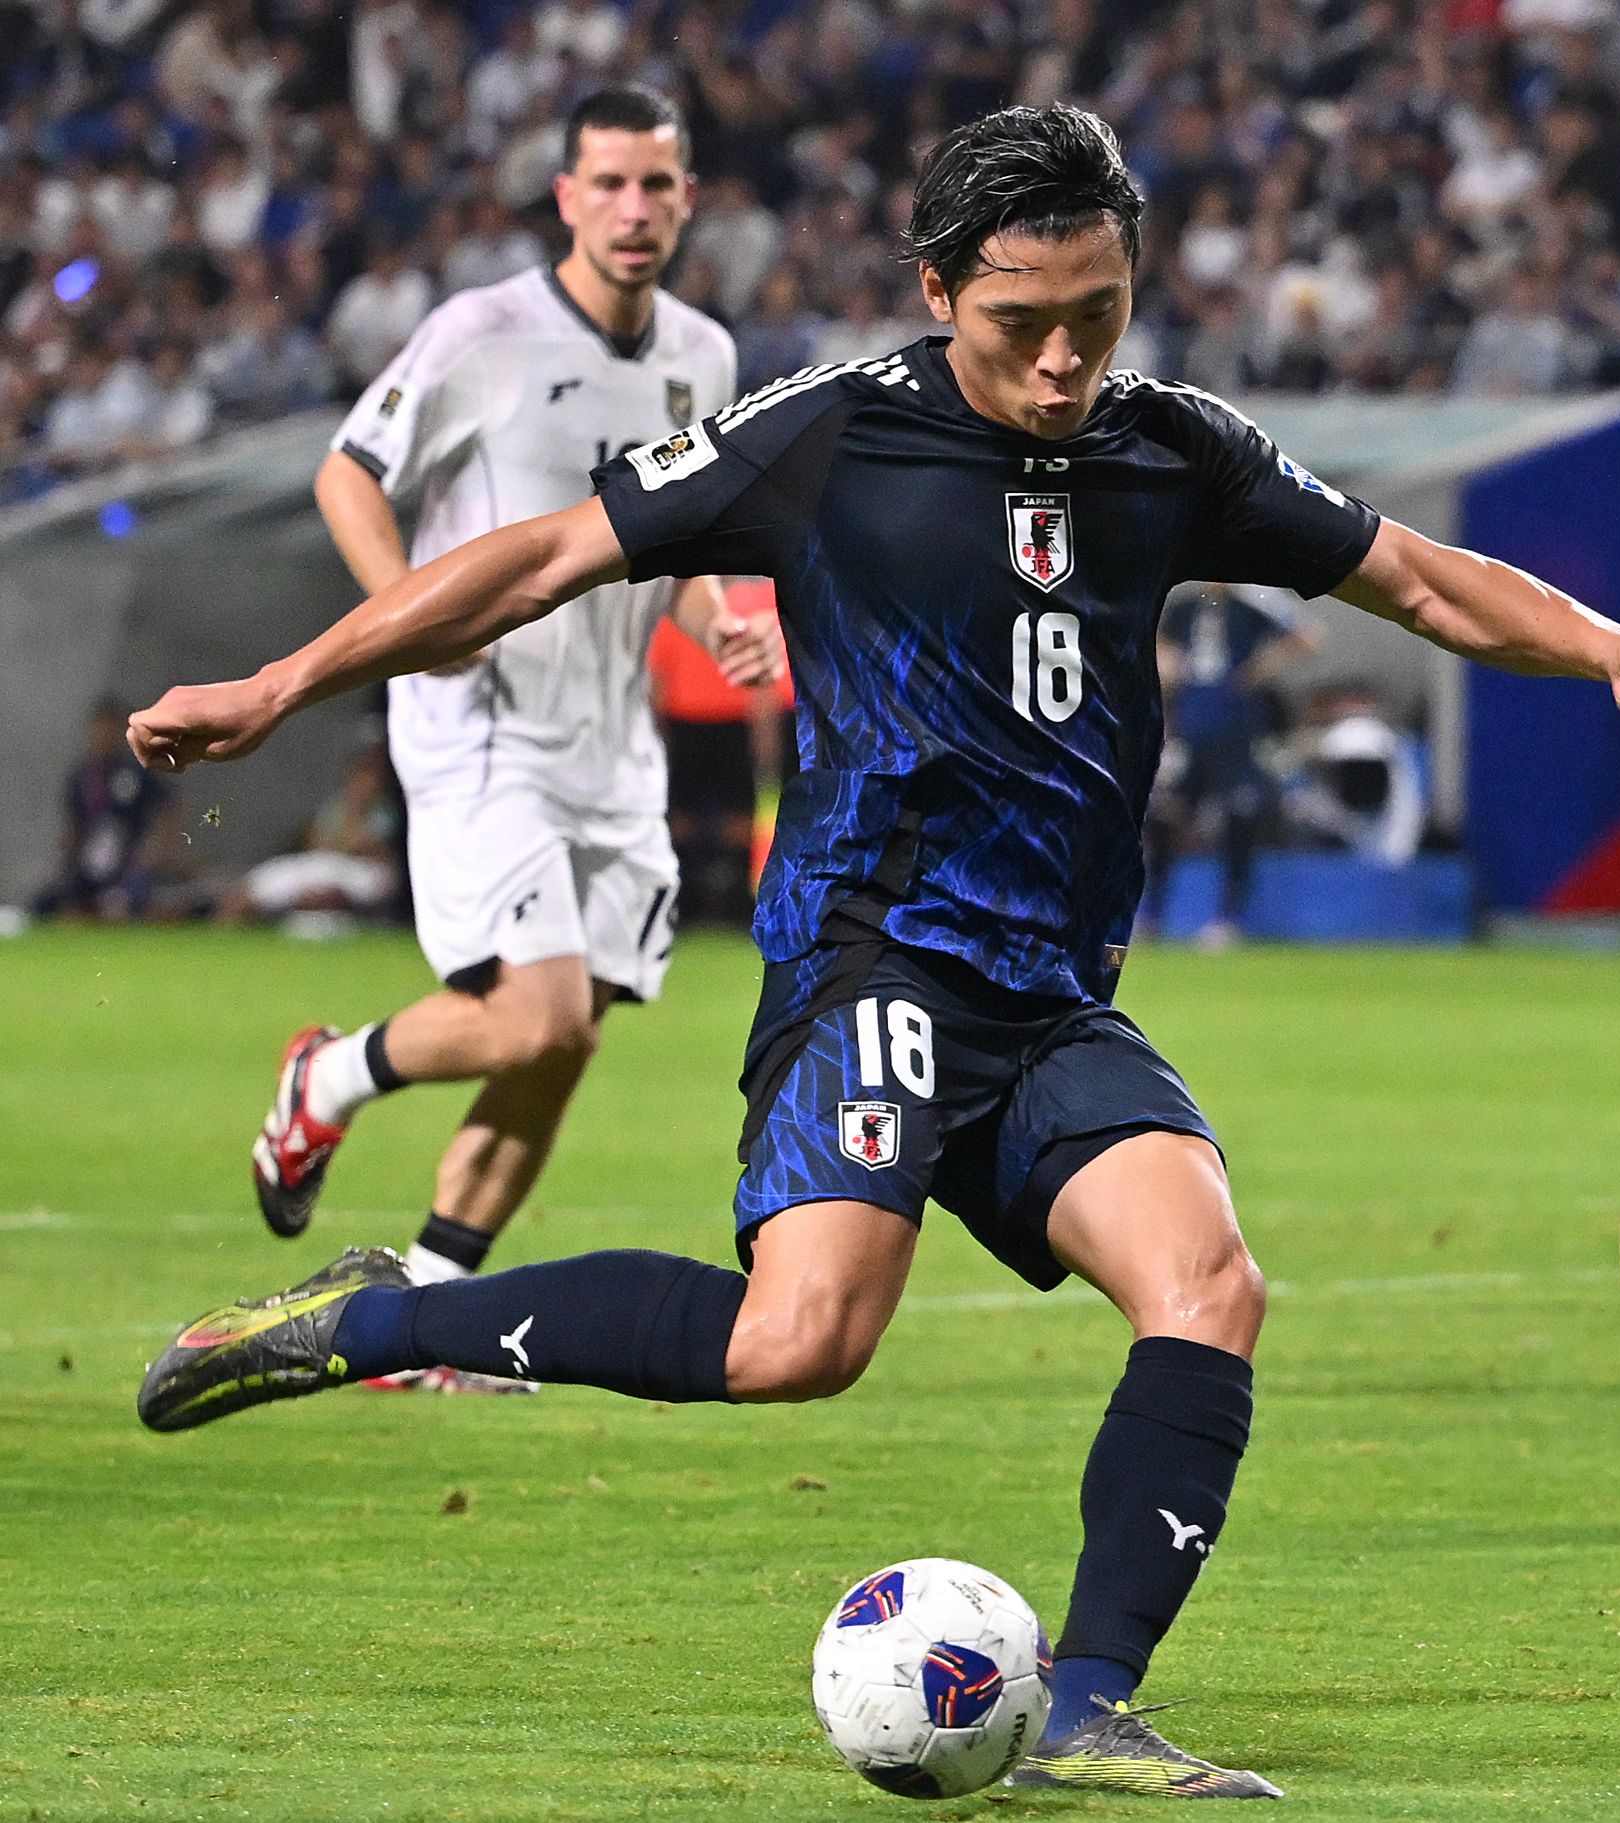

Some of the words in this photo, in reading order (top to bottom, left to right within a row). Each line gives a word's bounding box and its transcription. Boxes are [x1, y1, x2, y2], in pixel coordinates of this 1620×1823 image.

[1022, 497, 1055, 506] JAPAN
[1030, 559, 1056, 574] JFA
[1012, 612, 1083, 723] 18
[856, 997, 936, 1099] 18
[859, 1145, 883, 1158] JFA
